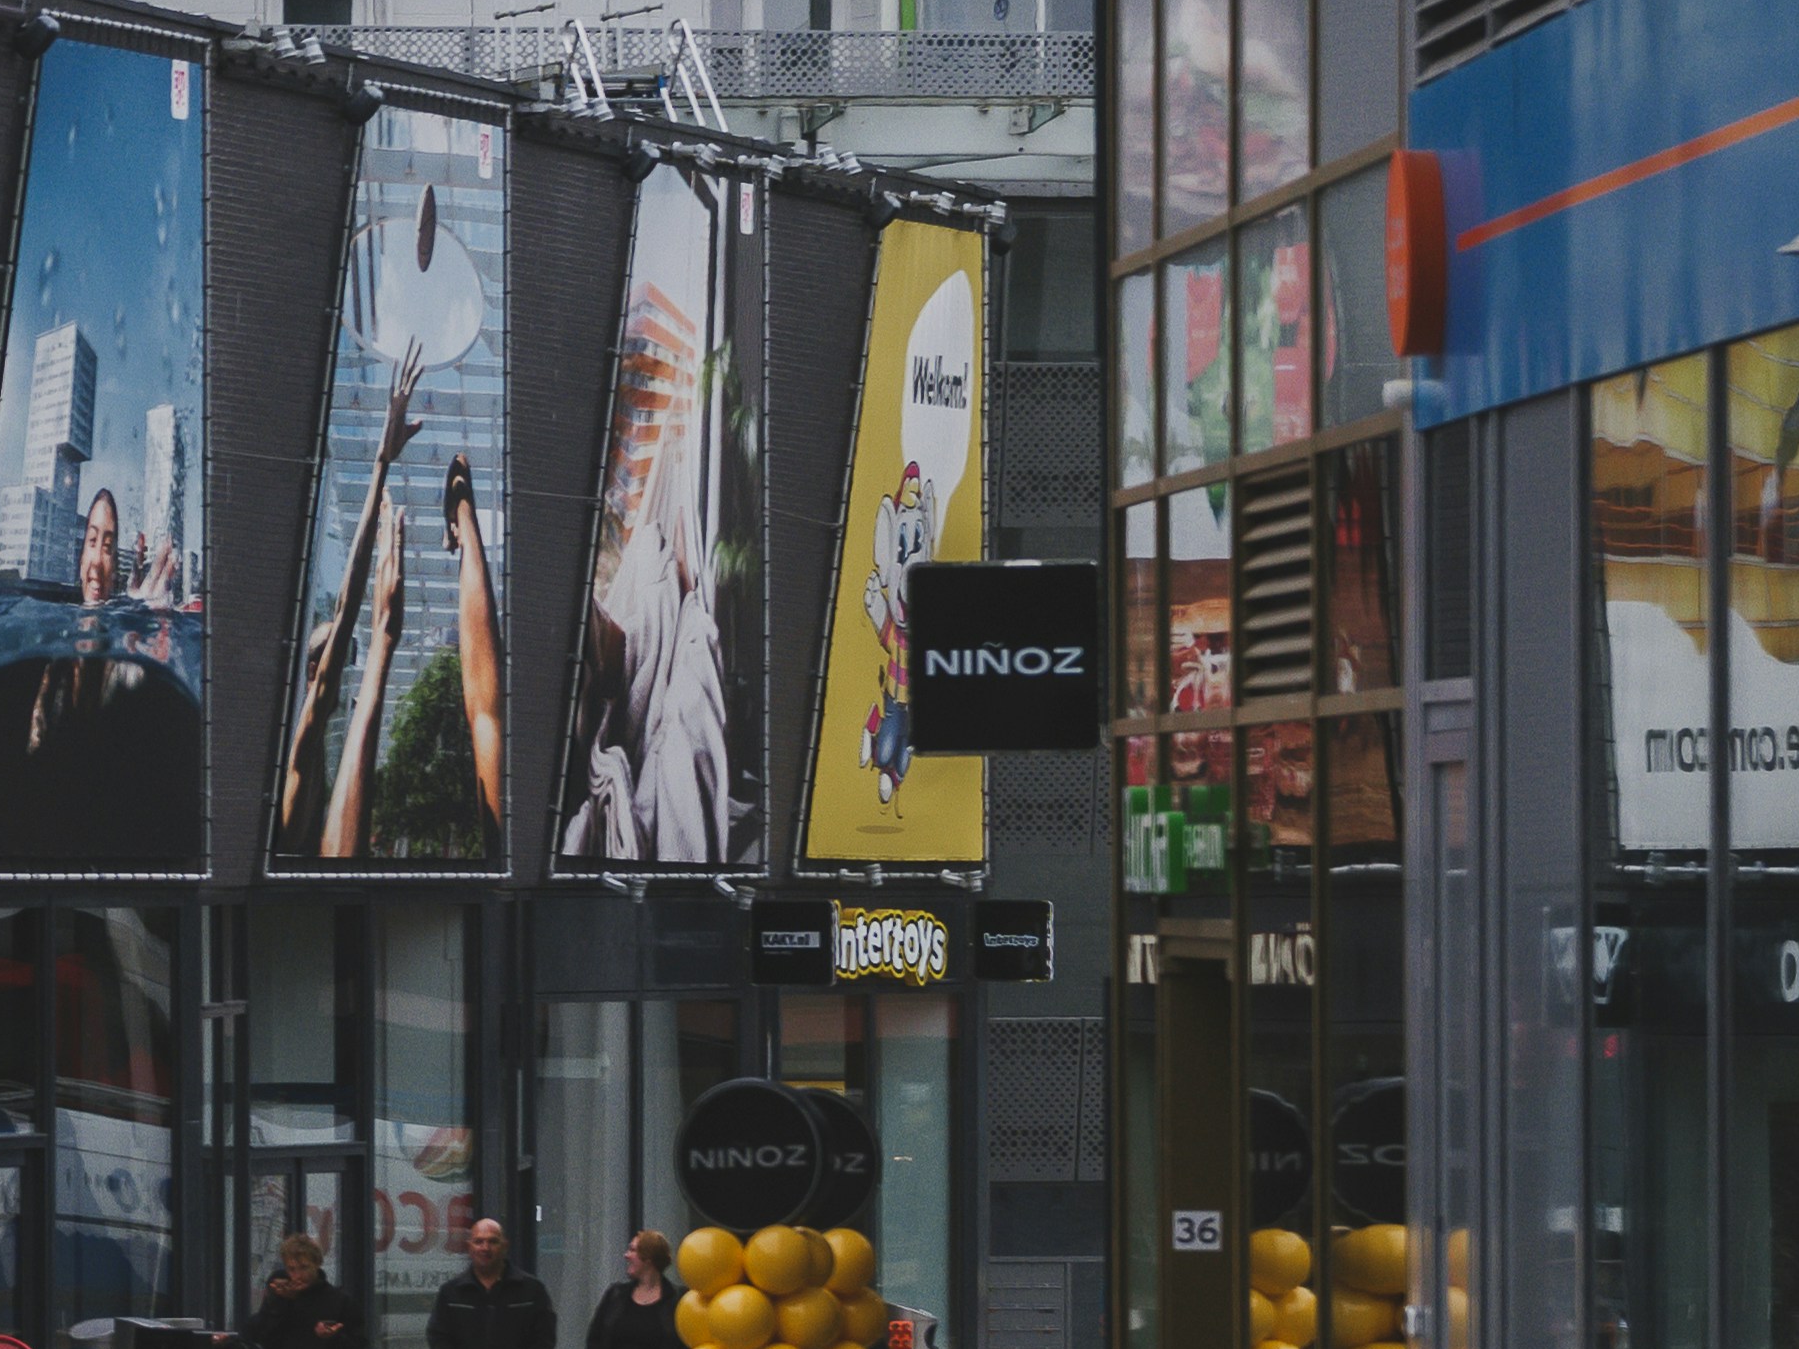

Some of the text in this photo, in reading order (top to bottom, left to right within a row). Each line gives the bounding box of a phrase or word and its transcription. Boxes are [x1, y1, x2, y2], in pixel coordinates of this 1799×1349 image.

[925, 641, 1085, 676] NIÑOZ
[833, 912, 947, 981] Intertoys
[1177, 1218, 1218, 1243] 36
